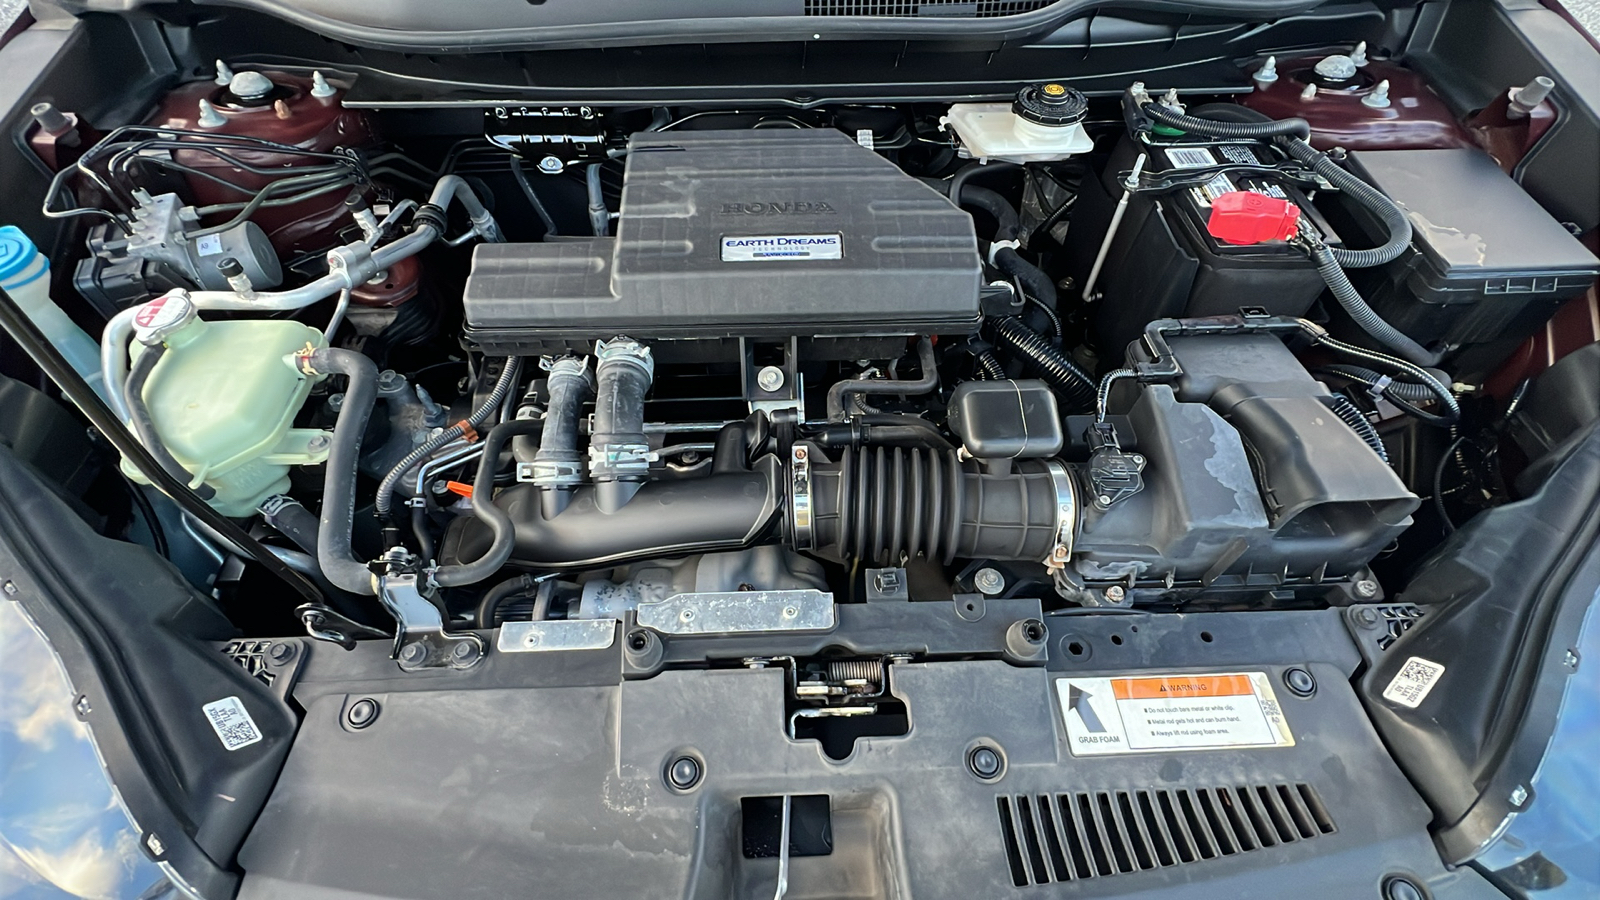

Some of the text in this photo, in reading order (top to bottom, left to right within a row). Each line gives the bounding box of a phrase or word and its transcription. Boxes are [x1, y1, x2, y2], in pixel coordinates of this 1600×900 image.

[720, 202, 837, 216] HONDA
[726, 237, 837, 247] EARTH DREAMS
[1168, 683, 1207, 692] WARNING
[1190, 729, 1203, 737] using
[1078, 735, 1120, 744] GRAB FOAM
